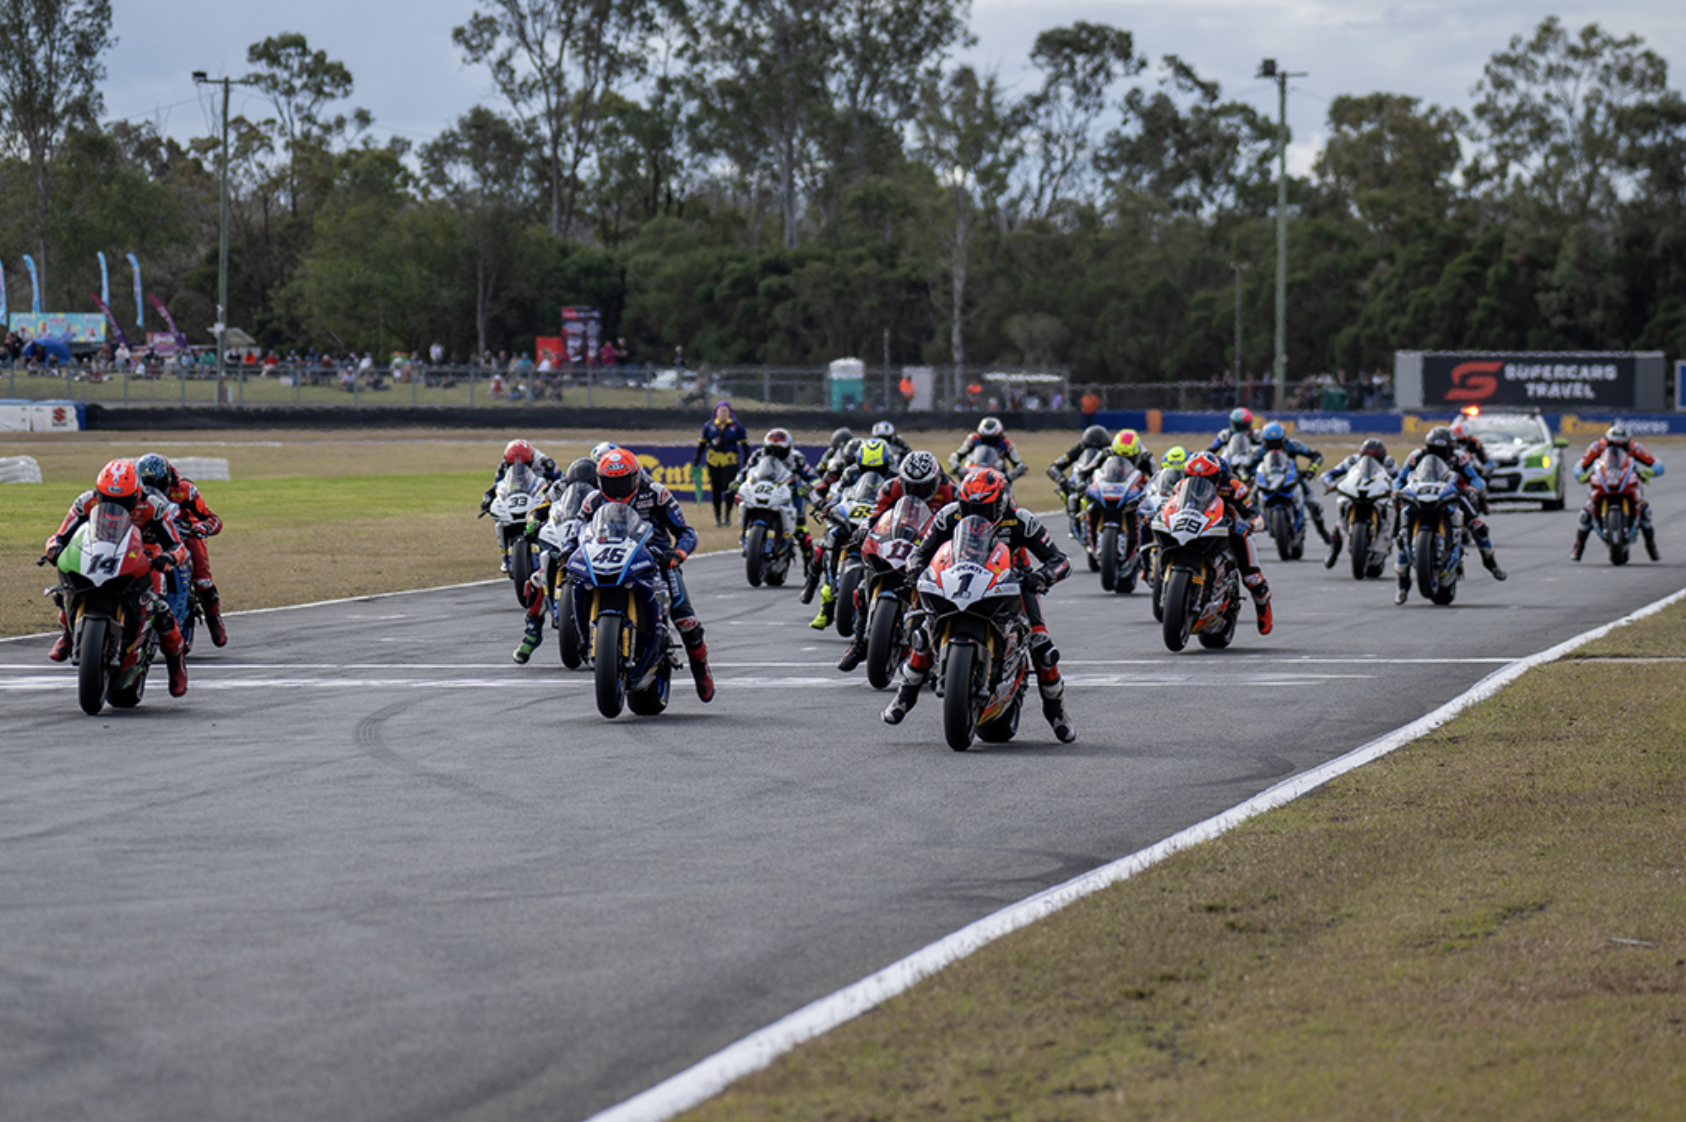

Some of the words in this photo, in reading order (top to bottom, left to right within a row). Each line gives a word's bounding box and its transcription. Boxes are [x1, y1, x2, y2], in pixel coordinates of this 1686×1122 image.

[1504, 364, 1618, 380] SUPERCARS
[1525, 382, 1596, 399] TRAVEL
[508, 496, 528, 509] 33
[1172, 517, 1202, 535] 29
[592, 546, 628, 564] 46
[887, 540, 914, 562] 11
[86, 554, 120, 575] 14
[951, 573, 974, 599] 1
